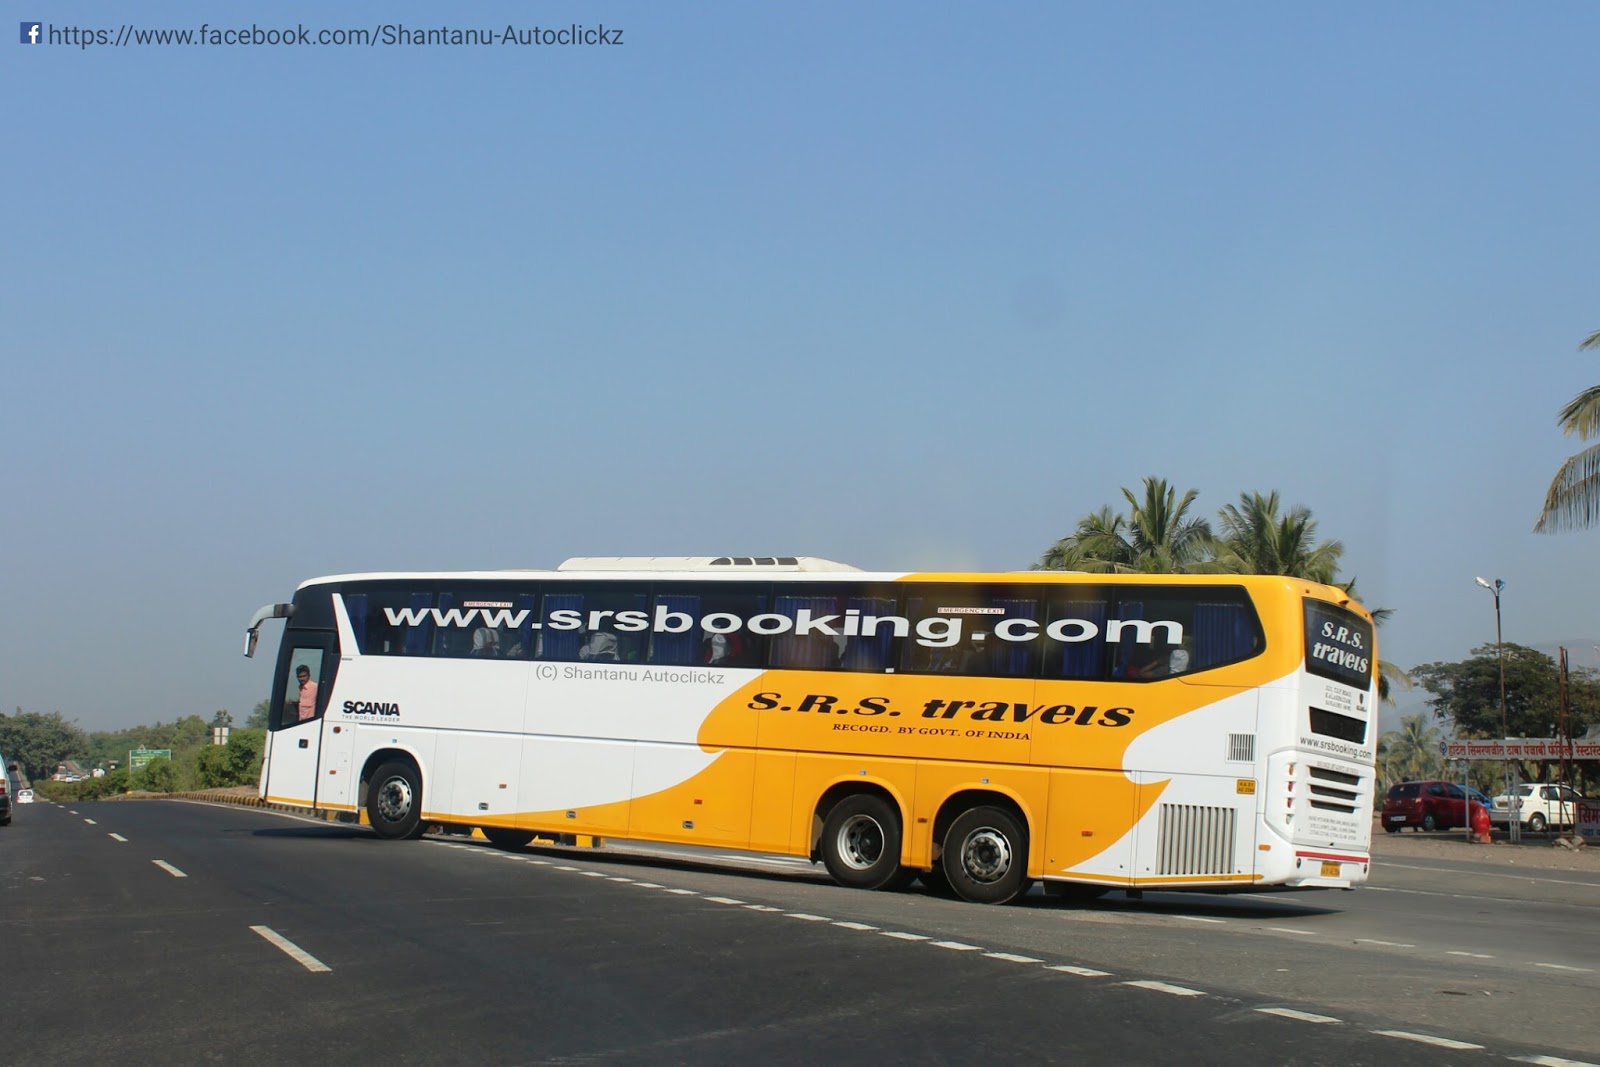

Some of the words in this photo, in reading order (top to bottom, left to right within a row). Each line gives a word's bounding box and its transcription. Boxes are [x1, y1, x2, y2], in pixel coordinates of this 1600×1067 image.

[383, 605, 1184, 649] www.srsbooking.com
[1321, 621, 1363, 650] S.R.S.
[1312, 642, 1369, 674] travels
[342, 700, 400, 717] SCANIA
[747, 692, 902, 717] S.R.S.
[921, 699, 1136, 728] travels
[832, 723, 892, 734] RECOGD.
[918, 728, 961, 737] GOVT.
[987, 732, 1031, 741] INDIA
[1300, 736, 1372, 759] www.srsbooking.com
